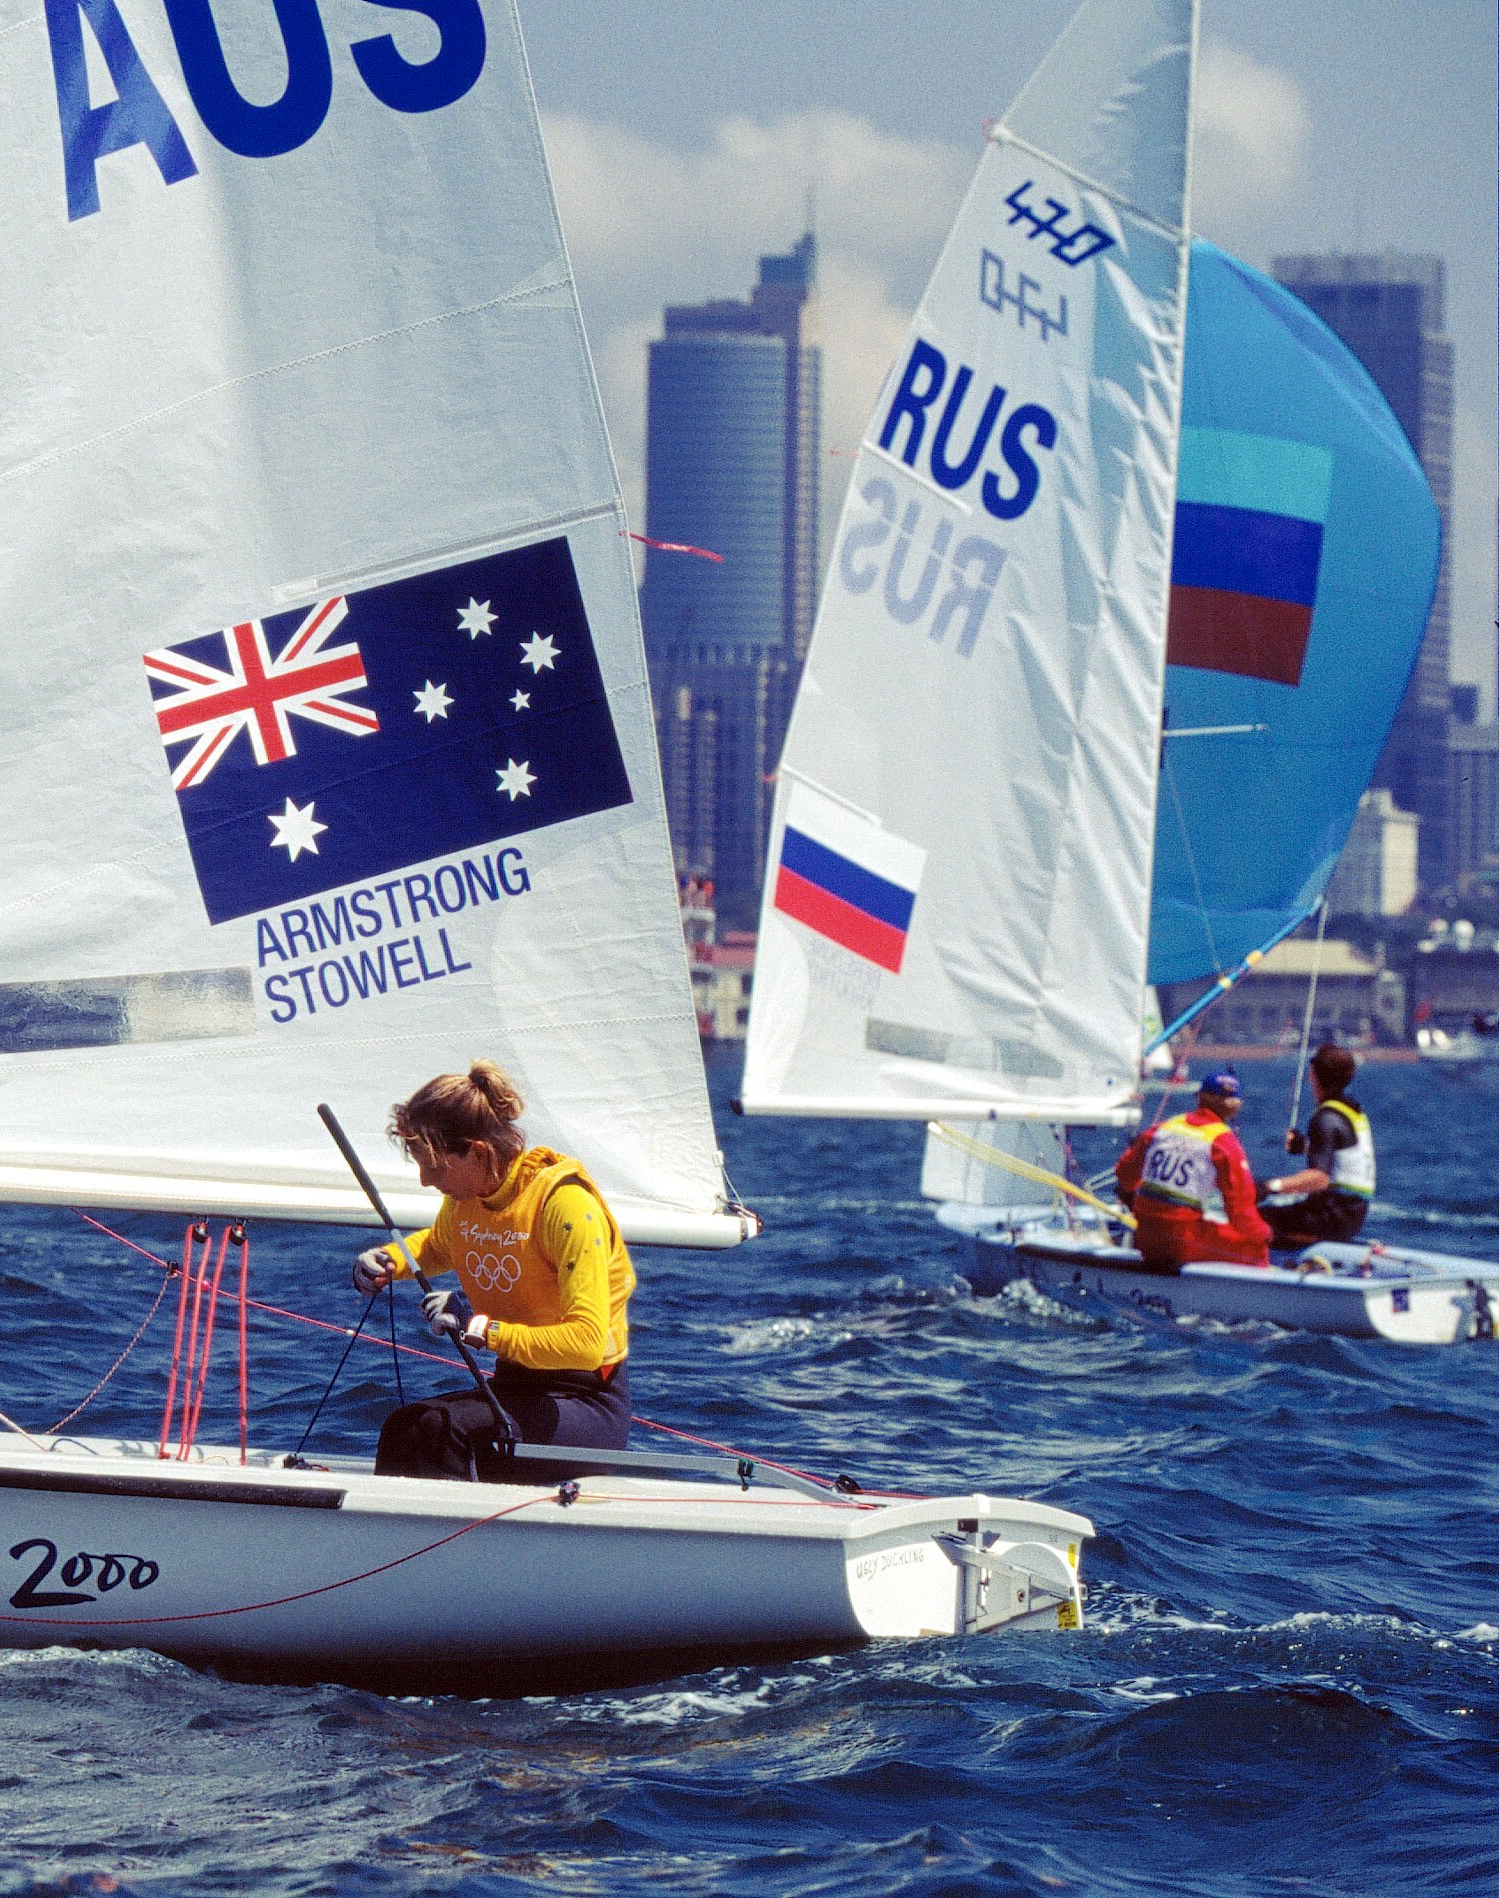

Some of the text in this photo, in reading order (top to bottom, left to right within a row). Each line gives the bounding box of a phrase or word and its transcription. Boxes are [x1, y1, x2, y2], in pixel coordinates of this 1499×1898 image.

[1004, 181, 1119, 267] 470
[879, 338, 1057, 522] RUS
[257, 847, 531, 968] ARMSTRONG
[264, 928, 472, 1023] STOWELL
[1148, 1149, 1194, 1187] RUS
[470, 1223, 530, 1248] Sydney 2000
[9, 1538, 160, 1609] 2000
